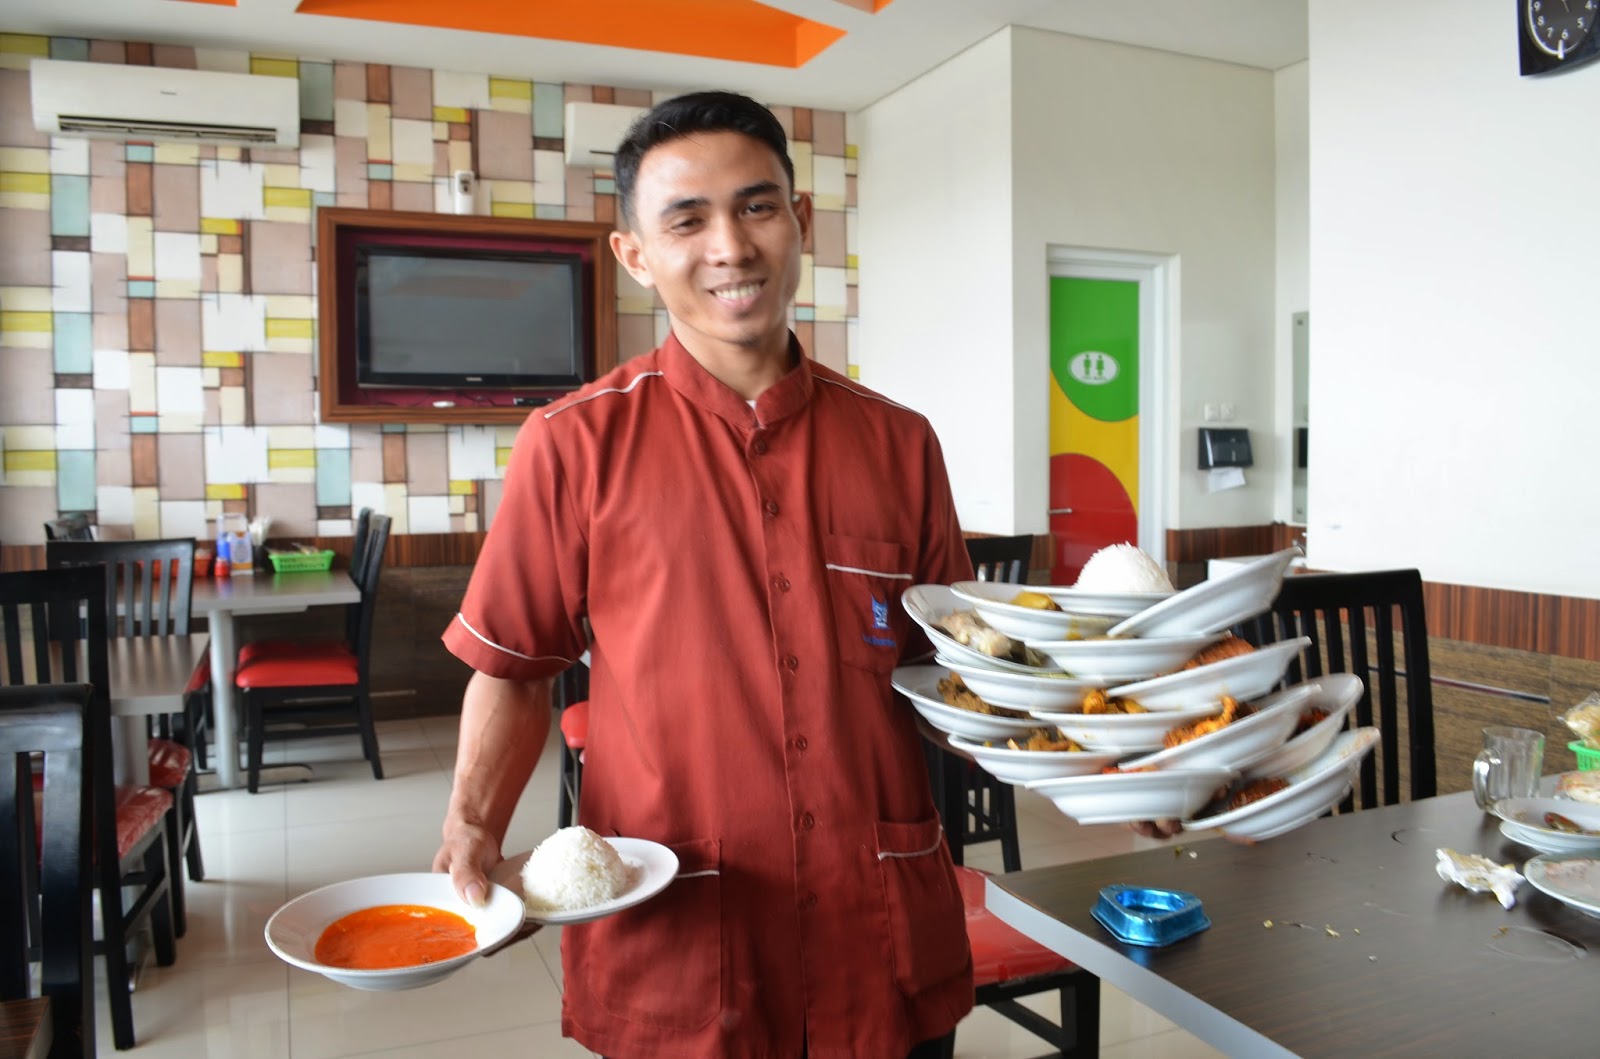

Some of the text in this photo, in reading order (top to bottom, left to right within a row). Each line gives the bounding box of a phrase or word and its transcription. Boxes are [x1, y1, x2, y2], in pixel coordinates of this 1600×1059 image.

[1533, 1, 1541, 12] 9
[1585, 0, 1593, 10] 4
[1537, 16, 1545, 26] 8
[1577, 17, 1584, 28] 5
[1547, 27, 1554, 38] 7
[1561, 28, 1569, 40] 6
